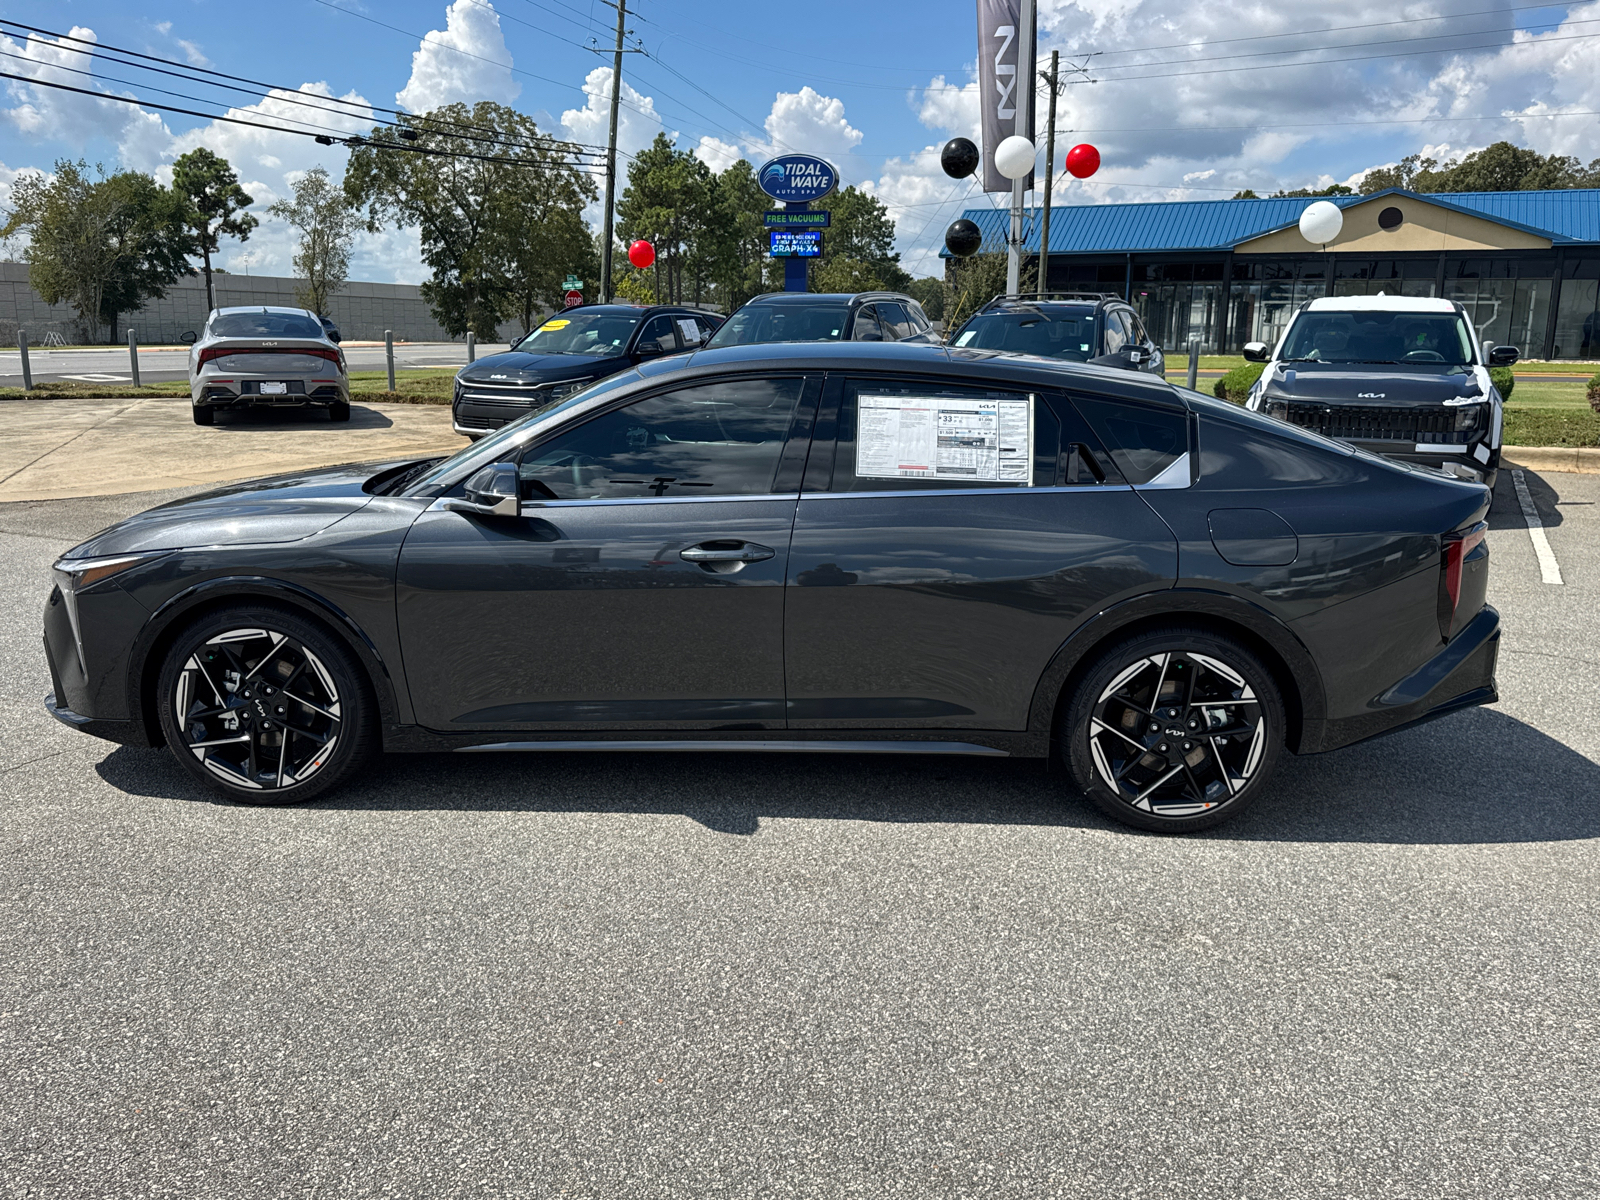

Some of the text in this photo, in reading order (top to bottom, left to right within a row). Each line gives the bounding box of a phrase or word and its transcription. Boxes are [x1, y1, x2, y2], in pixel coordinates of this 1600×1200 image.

[785, 164, 821, 175] TIDAL
[791, 176, 829, 188] WAVE
[766, 214, 825, 223] FREE VACUUMS
[566, 297, 582, 306] STOP
[942, 415, 953, 423] 33
